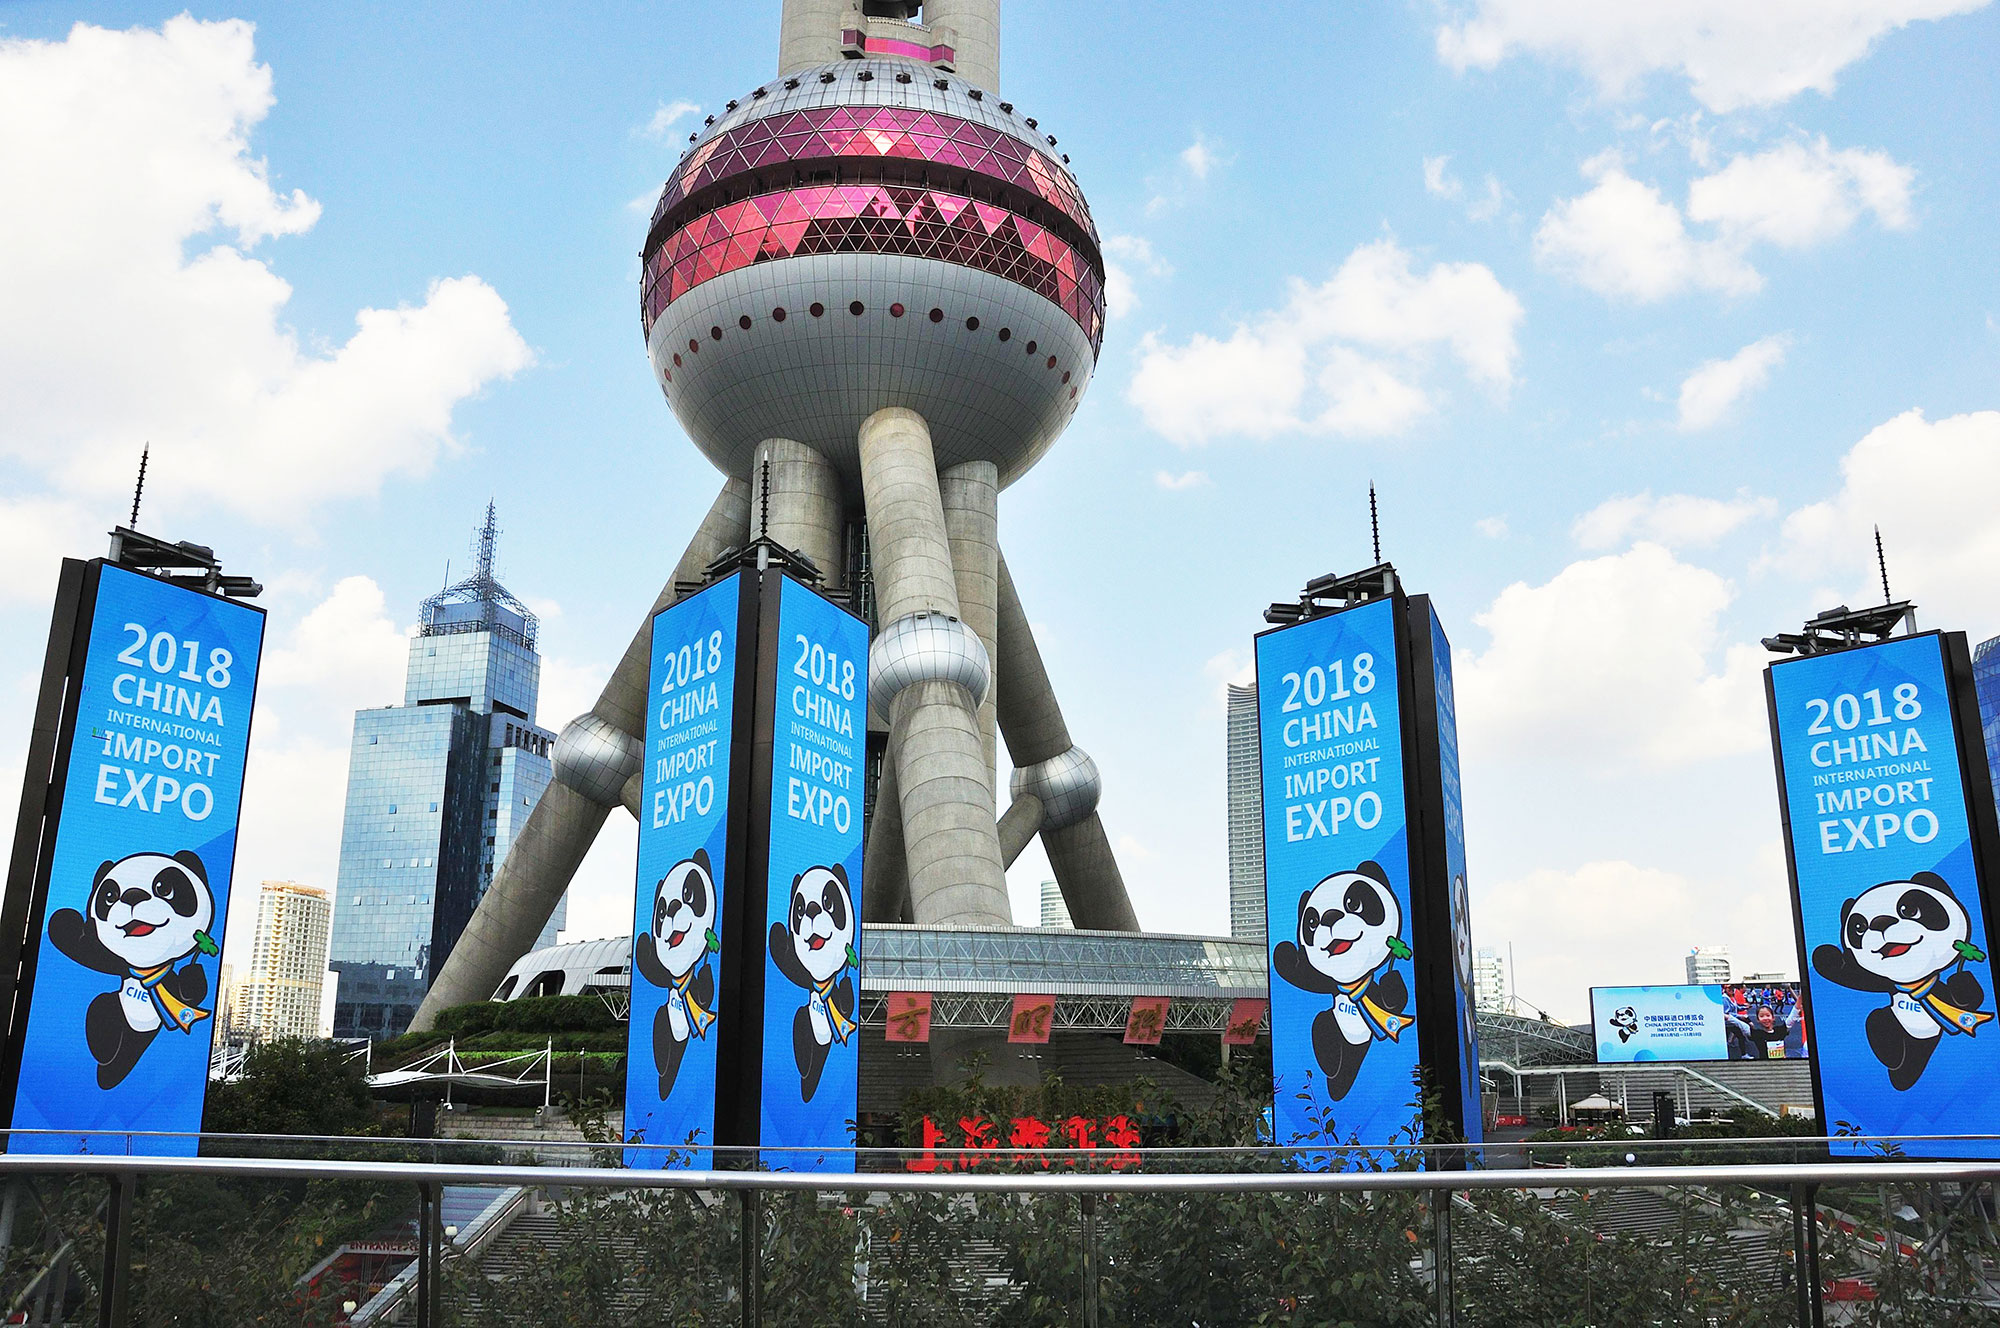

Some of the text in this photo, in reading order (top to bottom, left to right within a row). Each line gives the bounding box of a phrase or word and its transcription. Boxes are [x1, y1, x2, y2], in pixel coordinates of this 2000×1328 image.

[117, 622, 233, 689] 2018
[661, 629, 723, 694] 2018
[793, 634, 855, 701] 2018
[112, 673, 224, 727] CHINA
[659, 681, 719, 731] CHINA
[1281, 652, 1376, 714] 2018
[107, 709, 222, 747] INTERNATIONAL
[792, 685, 853, 739] CHINA
[1282, 701, 1378, 748] CHINA
[1805, 682, 1922, 736] 2018
[101, 730, 221, 777] IMPORT
[657, 719, 718, 752] INTERNATIONAL
[790, 721, 852, 759] INTERNATIONAL
[1283, 737, 1380, 769] INTERNATIONAL
[1810, 727, 1928, 768] CHINA
[655, 739, 718, 784] IMPORT
[789, 742, 853, 790] IMPORT
[1284, 756, 1381, 799] IMPORT
[1812, 760, 1931, 787] INTERNATIONAL
[94, 763, 214, 821] EXPO
[653, 775, 714, 830] EXPO
[787, 776, 851, 834] EXPO
[1815, 777, 1934, 815] IMPORT
[1285, 790, 1383, 843] EXPO
[1819, 808, 1940, 855] EXPO
[126, 986, 149, 1003] CIIE
[670, 997, 683, 1012] CIIE
[812, 1000, 825, 1016] CIIE
[1338, 1002, 1358, 1016] CIIE
[1897, 1000, 1921, 1013] CIIE
